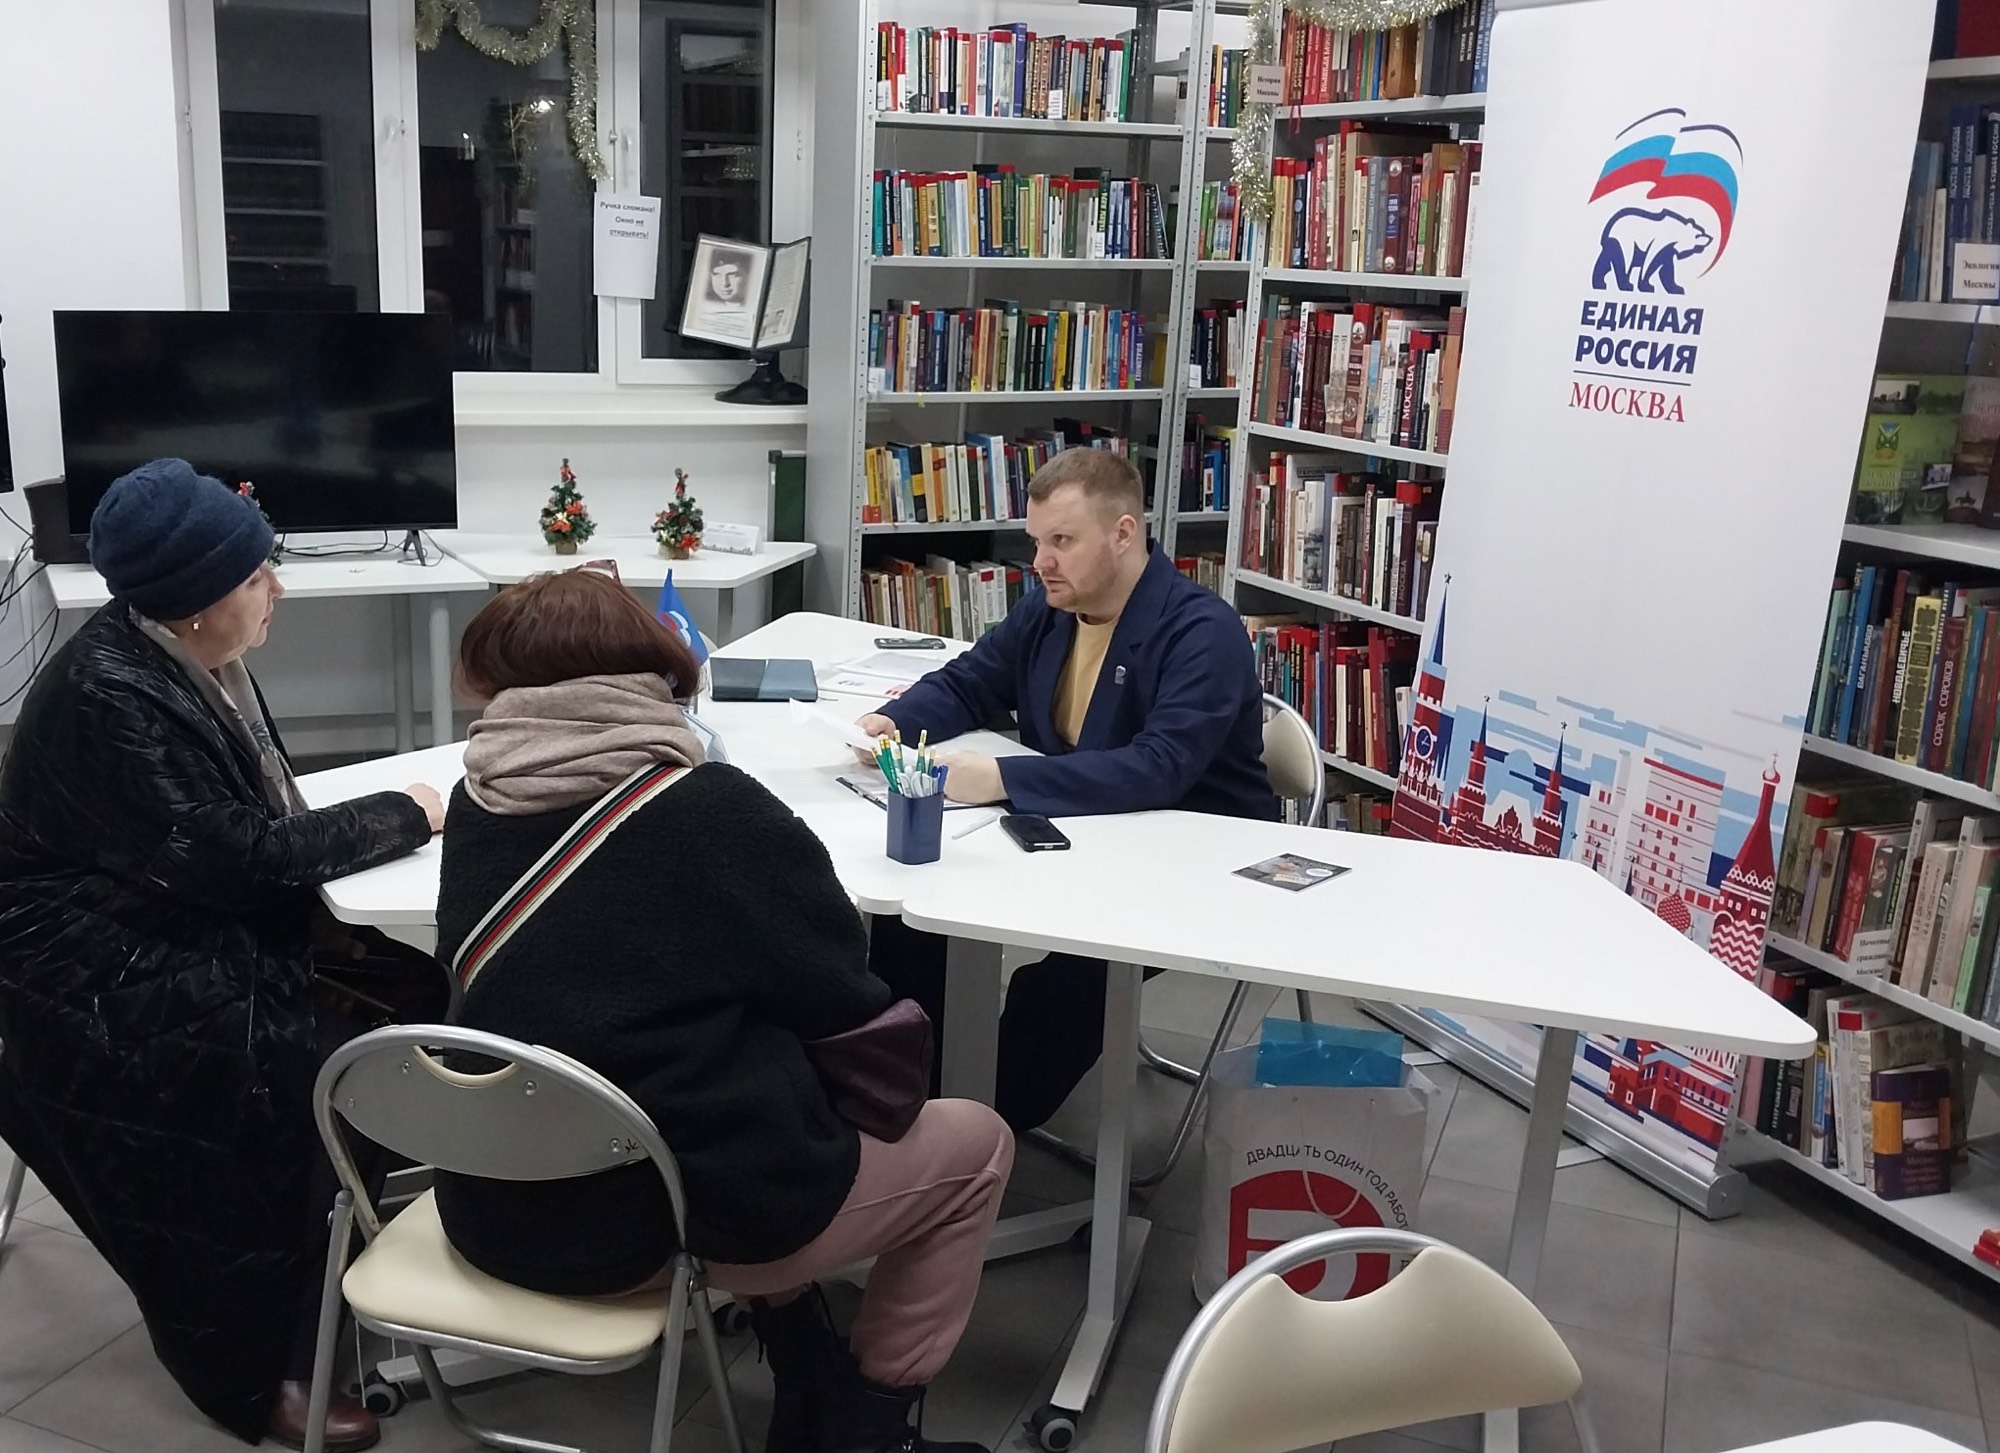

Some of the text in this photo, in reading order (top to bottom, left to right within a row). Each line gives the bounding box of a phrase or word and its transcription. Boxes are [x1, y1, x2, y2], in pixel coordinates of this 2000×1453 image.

[1257, 76, 1281, 85] История
[600, 201, 621, 210] Ручка
[615, 216, 634, 224] Окно
[609, 230, 649, 239] открывать!
[1963, 260, 2000, 271] Экология
[1963, 279, 1996, 290] Москвы
[1580, 300, 1704, 335] ЕДИНАЯ
[1575, 334, 1698, 374] РОССИЯ
[1402, 364, 1416, 420] МОСКВА
[1568, 381, 1686, 423] МОСКВА
[1857, 624, 1873, 690] ВАГАНЬКОВО
[1892, 630, 1911, 703] НОВОДЕВИЧЬЕ
[1939, 660, 1954, 707] СОРОКОВ
[1933, 711, 1947, 746] СОРОК
[1860, 939, 1890, 947] Почетны
[1246, 1144, 1410, 1230] ДВАДЦТЬ ОДИН ГОД РАБОТ
